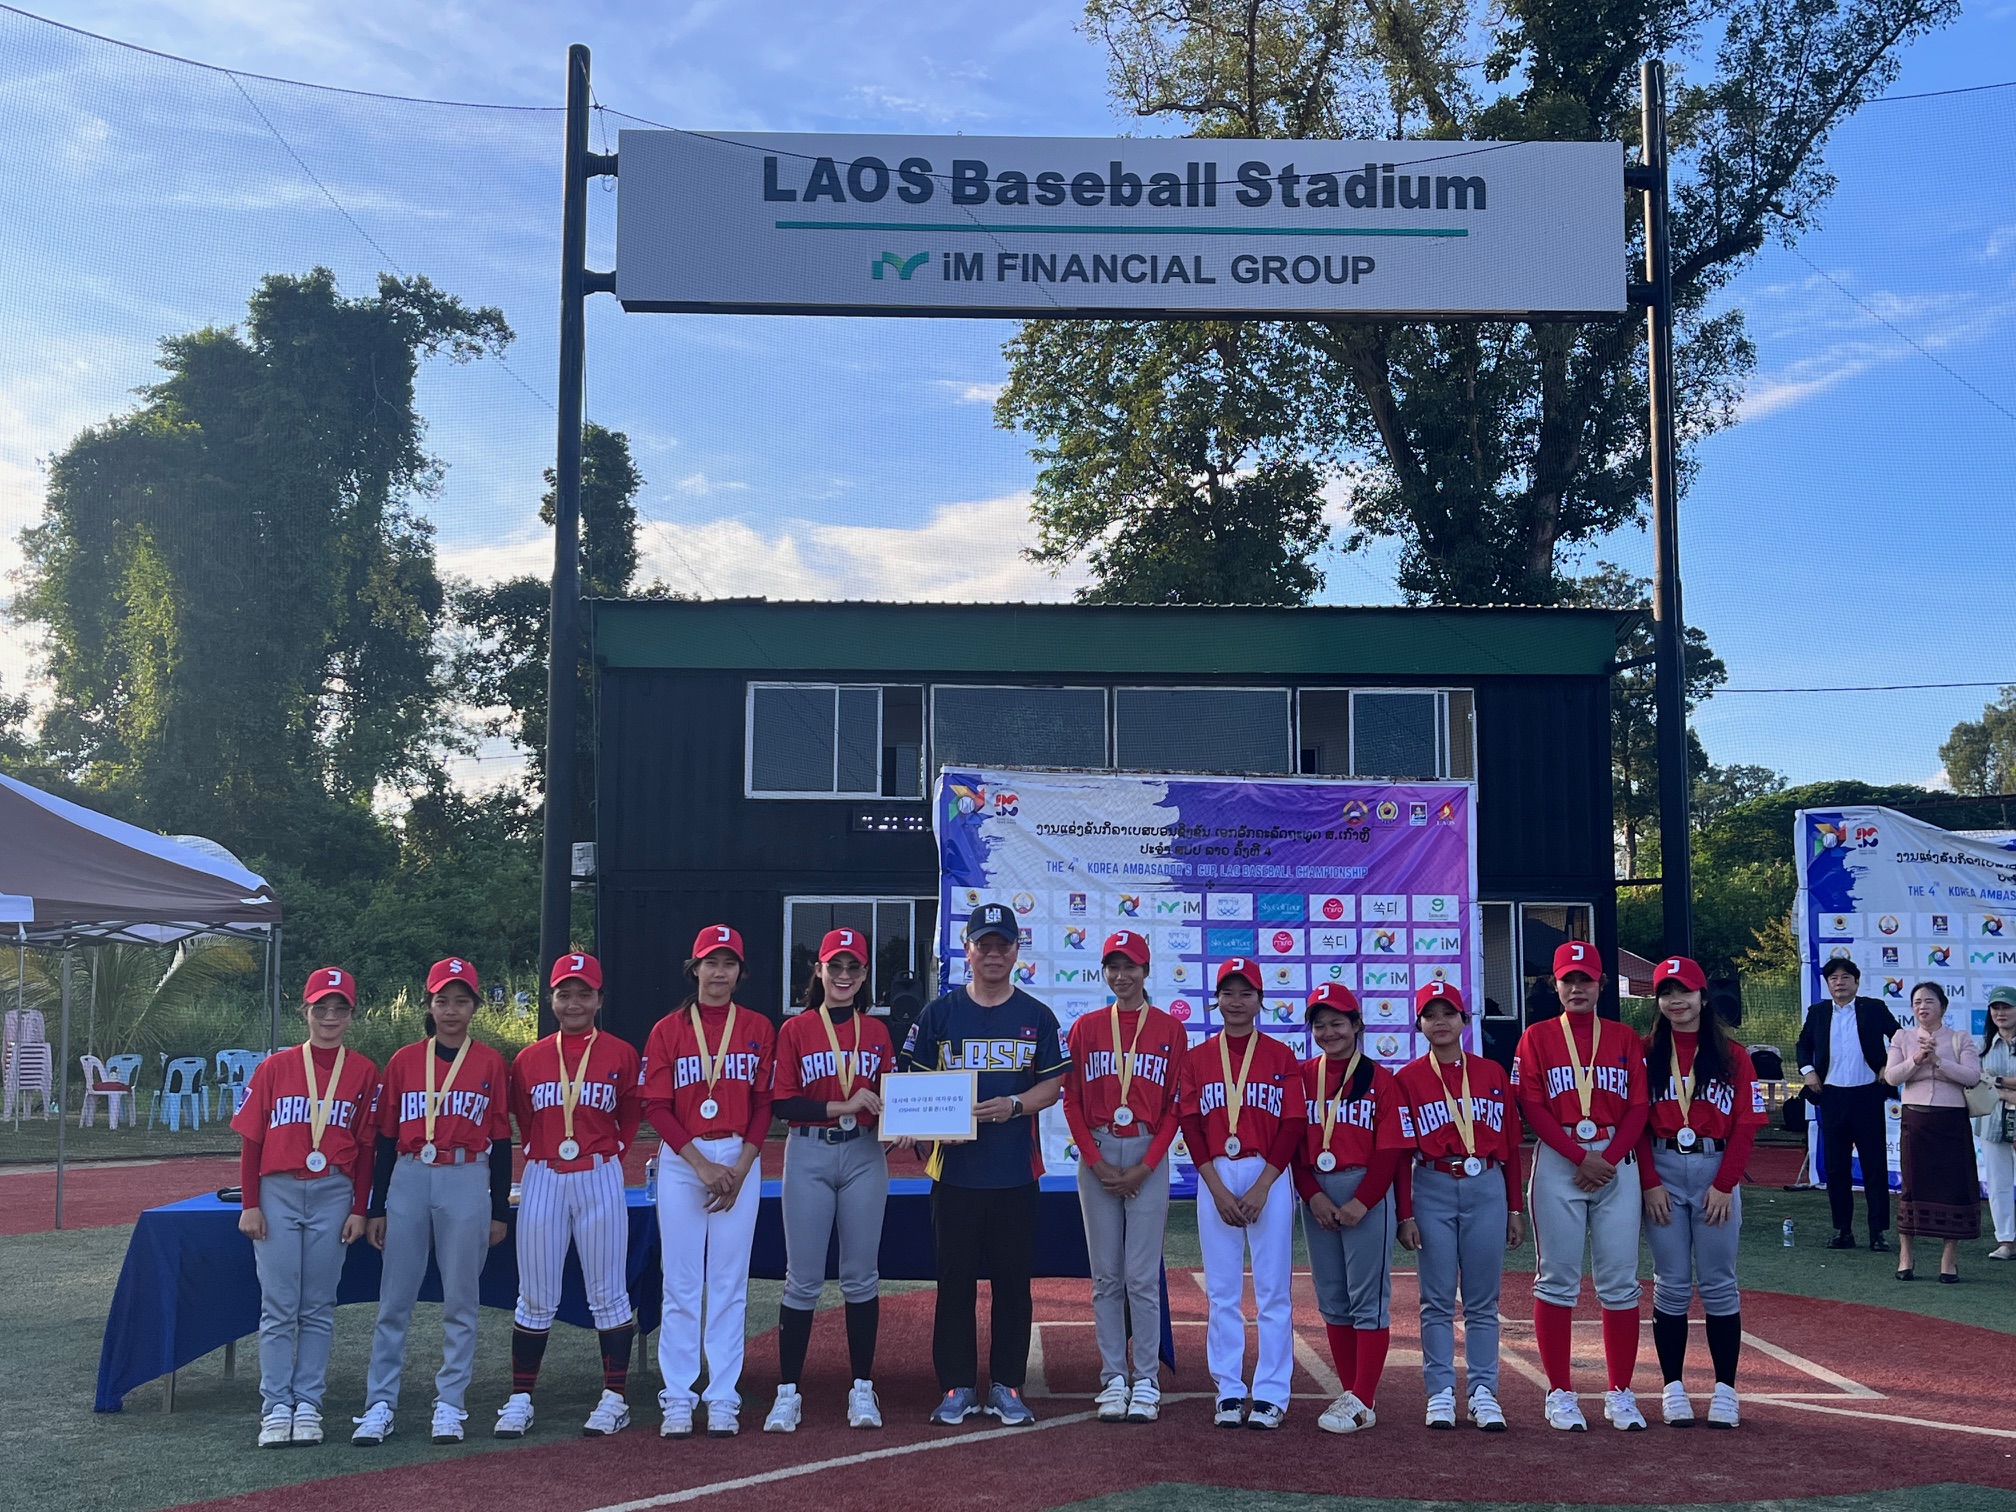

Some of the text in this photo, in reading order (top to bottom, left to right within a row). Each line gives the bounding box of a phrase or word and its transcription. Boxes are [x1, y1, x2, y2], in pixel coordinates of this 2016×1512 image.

[764, 155, 1487, 210] LAOS Baseball Stadium
[943, 253, 1375, 284] iM FINANCIAL GROUP
[1264, 847, 1271, 856] 4
[1046, 861, 1064, 872] THE
[1088, 862, 1119, 874] KOREA
[1220, 864, 1240, 878] LAO
[1242, 864, 1293, 878] BASEBALL
[1296, 866, 1368, 879] CHAMPIONSHIP
[1908, 885, 1924, 896] THE
[1948, 886, 1976, 898] KOREA
[1183, 901, 1200, 913] iM
[1373, 901, 1397, 915] 쏙디
[717, 926, 730, 941] J
[840, 930, 853, 945] J
[1115, 932, 1129, 946] J
[1322, 935, 1347, 949] 쏙디
[1441, 937, 1459, 950] iM
[1571, 945, 1584, 961] J
[449, 959, 463, 974] S
[570, 956, 585, 971] J
[1231, 958, 1244, 970] J
[1667, 960, 1680, 974] J
[328, 971, 342, 986] J
[1082, 969, 1100, 982] iM
[1391, 972, 1408, 985] iM
[1318, 985, 1330, 1000] J
[1432, 982, 1444, 995] J
[1946, 985, 1964, 997] iM
[938, 1039, 1037, 1071] LBSF
